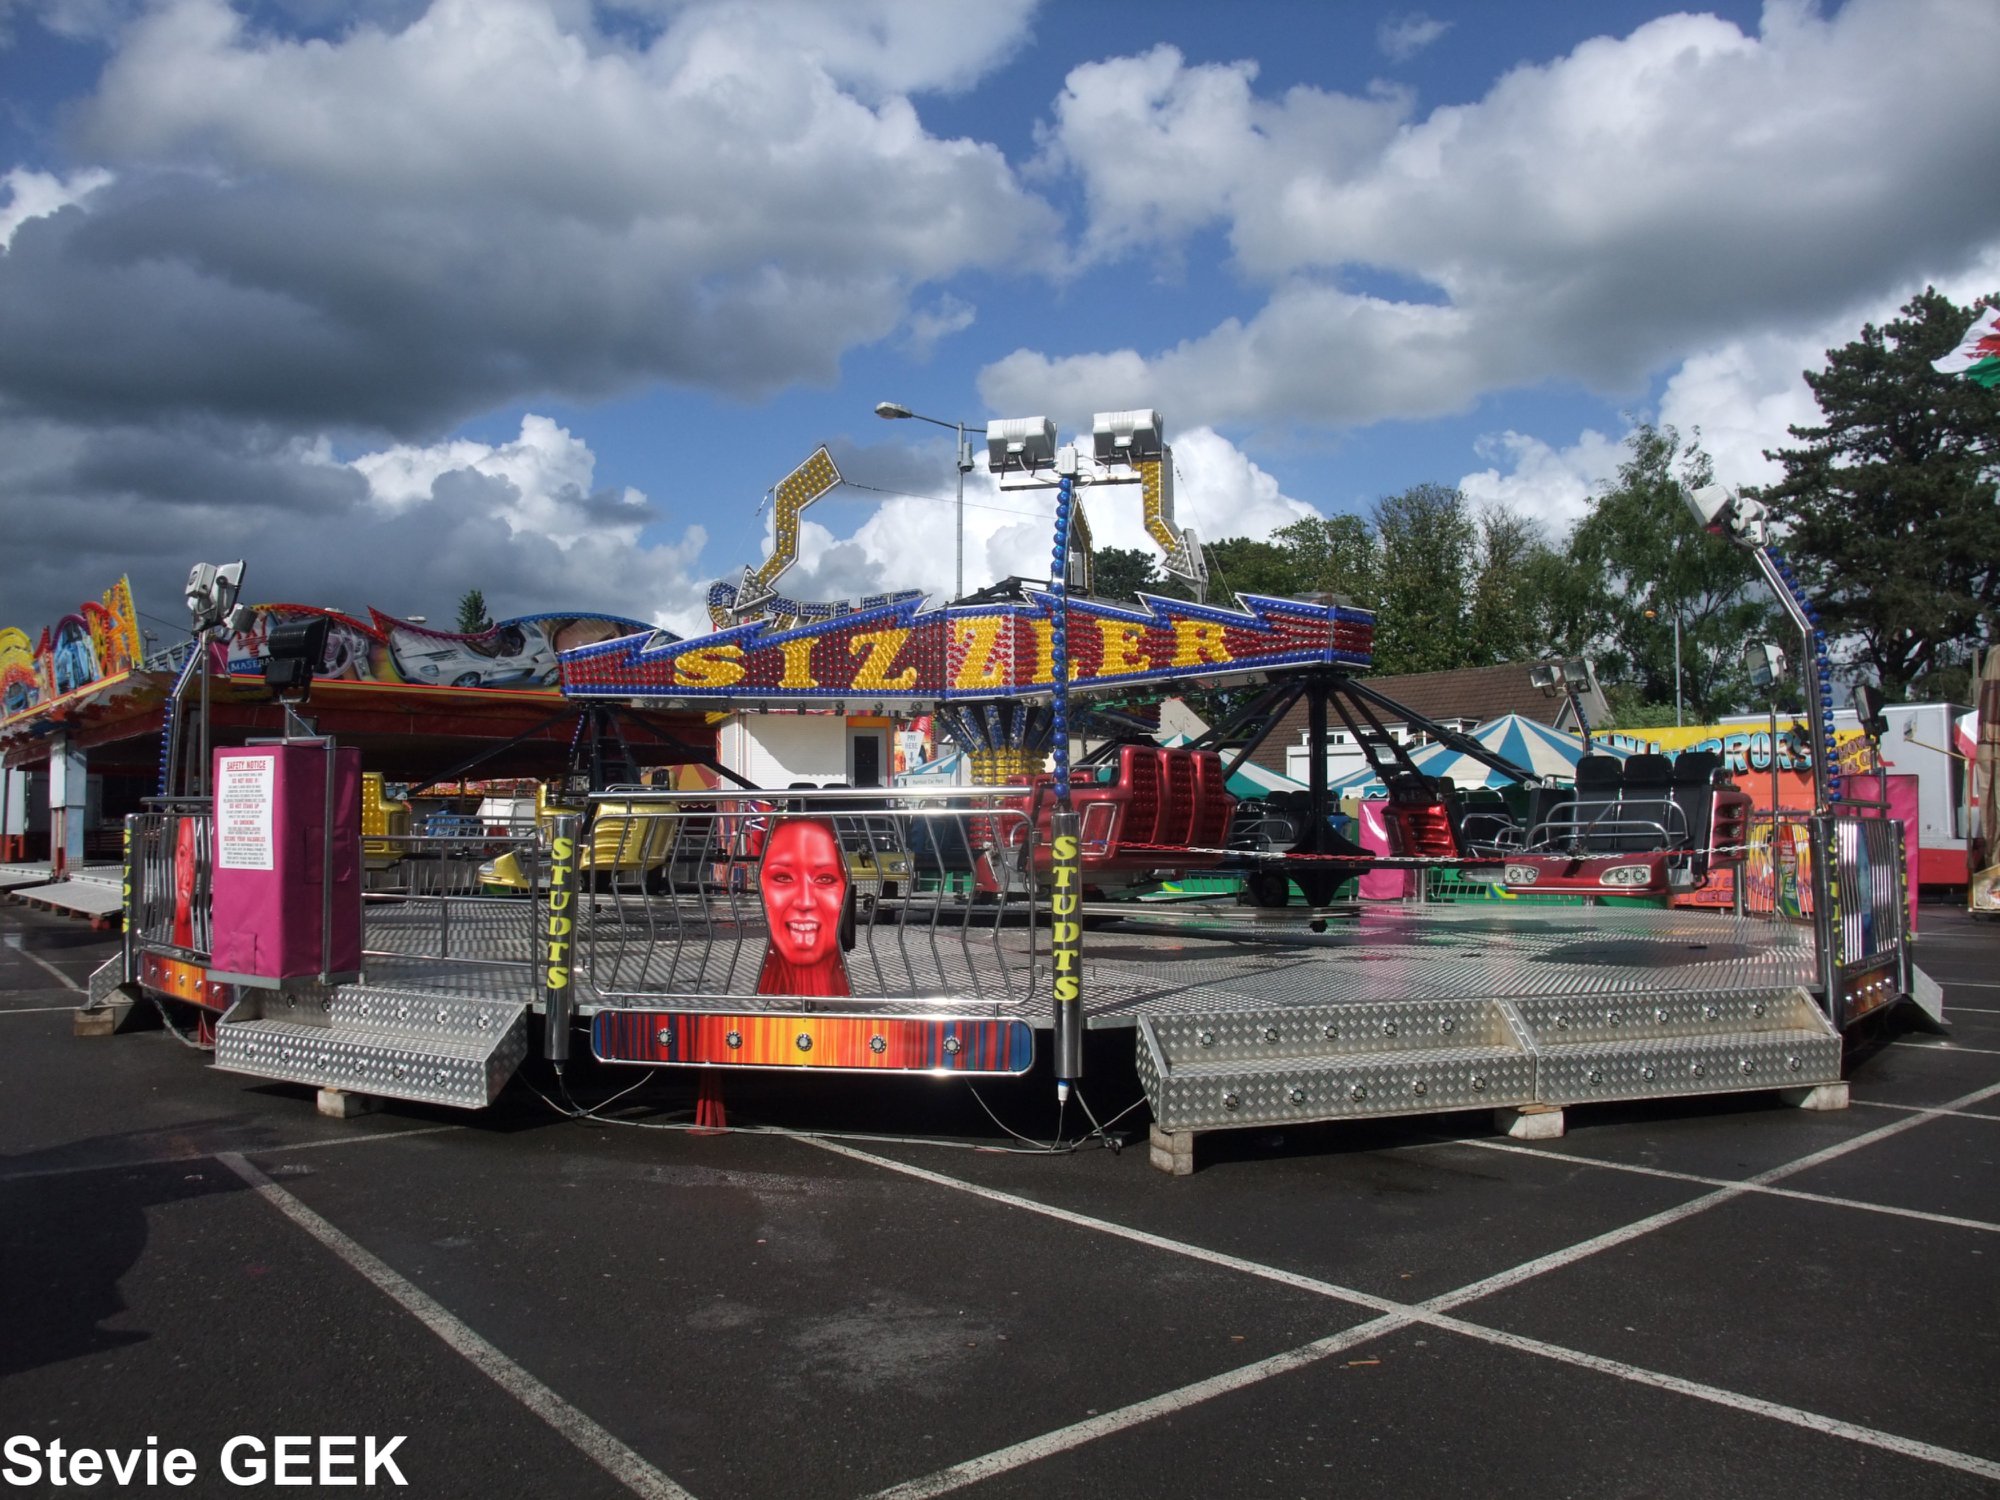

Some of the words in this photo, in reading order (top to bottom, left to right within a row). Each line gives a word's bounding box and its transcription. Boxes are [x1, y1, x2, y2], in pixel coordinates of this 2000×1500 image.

[674, 616, 1234, 690] SIZZLER
[226, 761, 245, 770] SAFETY
[246, 760, 266, 769] NOTICE
[547, 837, 573, 989] STUDTS
[1052, 835, 1080, 1001] STUDTS
